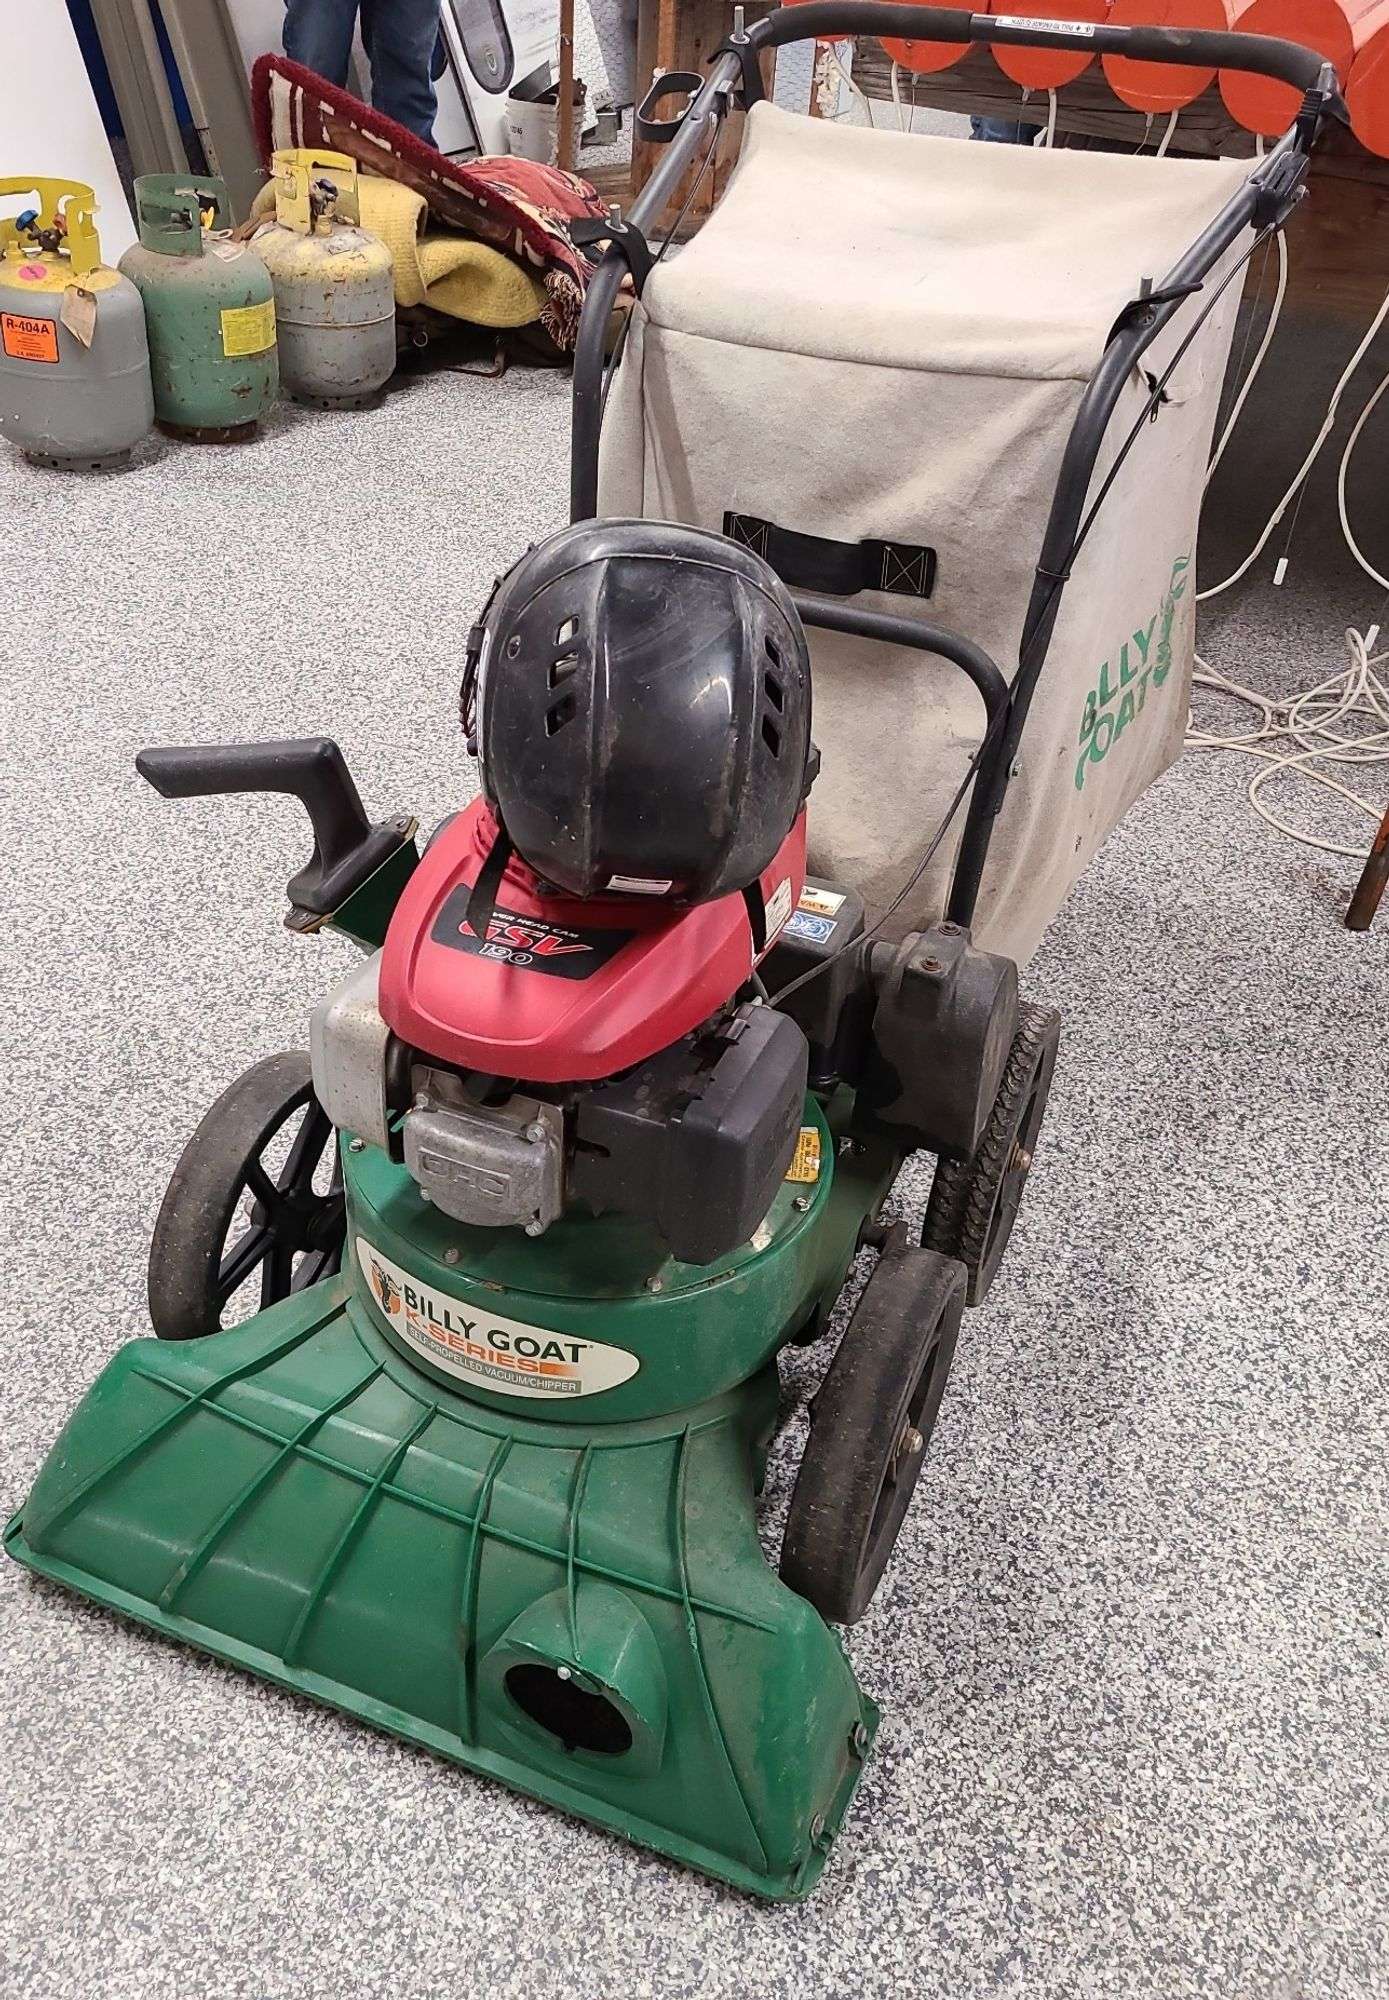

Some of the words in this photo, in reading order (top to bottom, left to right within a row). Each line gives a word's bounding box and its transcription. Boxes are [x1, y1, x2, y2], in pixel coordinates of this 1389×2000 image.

[6, 318, 50, 334] R-404A
[492, 911, 515, 922] VER
[517, 918, 549, 930] HEAD
[552, 928, 579, 938] CAM
[478, 943, 533, 965] 190
[403, 1284, 477, 1340] BILLY
[487, 1329, 588, 1363] GOAT
[405, 1306, 540, 1374] K-SERIES
[408, 1327, 484, 1374] SELF-PROPELLED
[485, 1366, 577, 1392] VACUUM/CHIPPER
